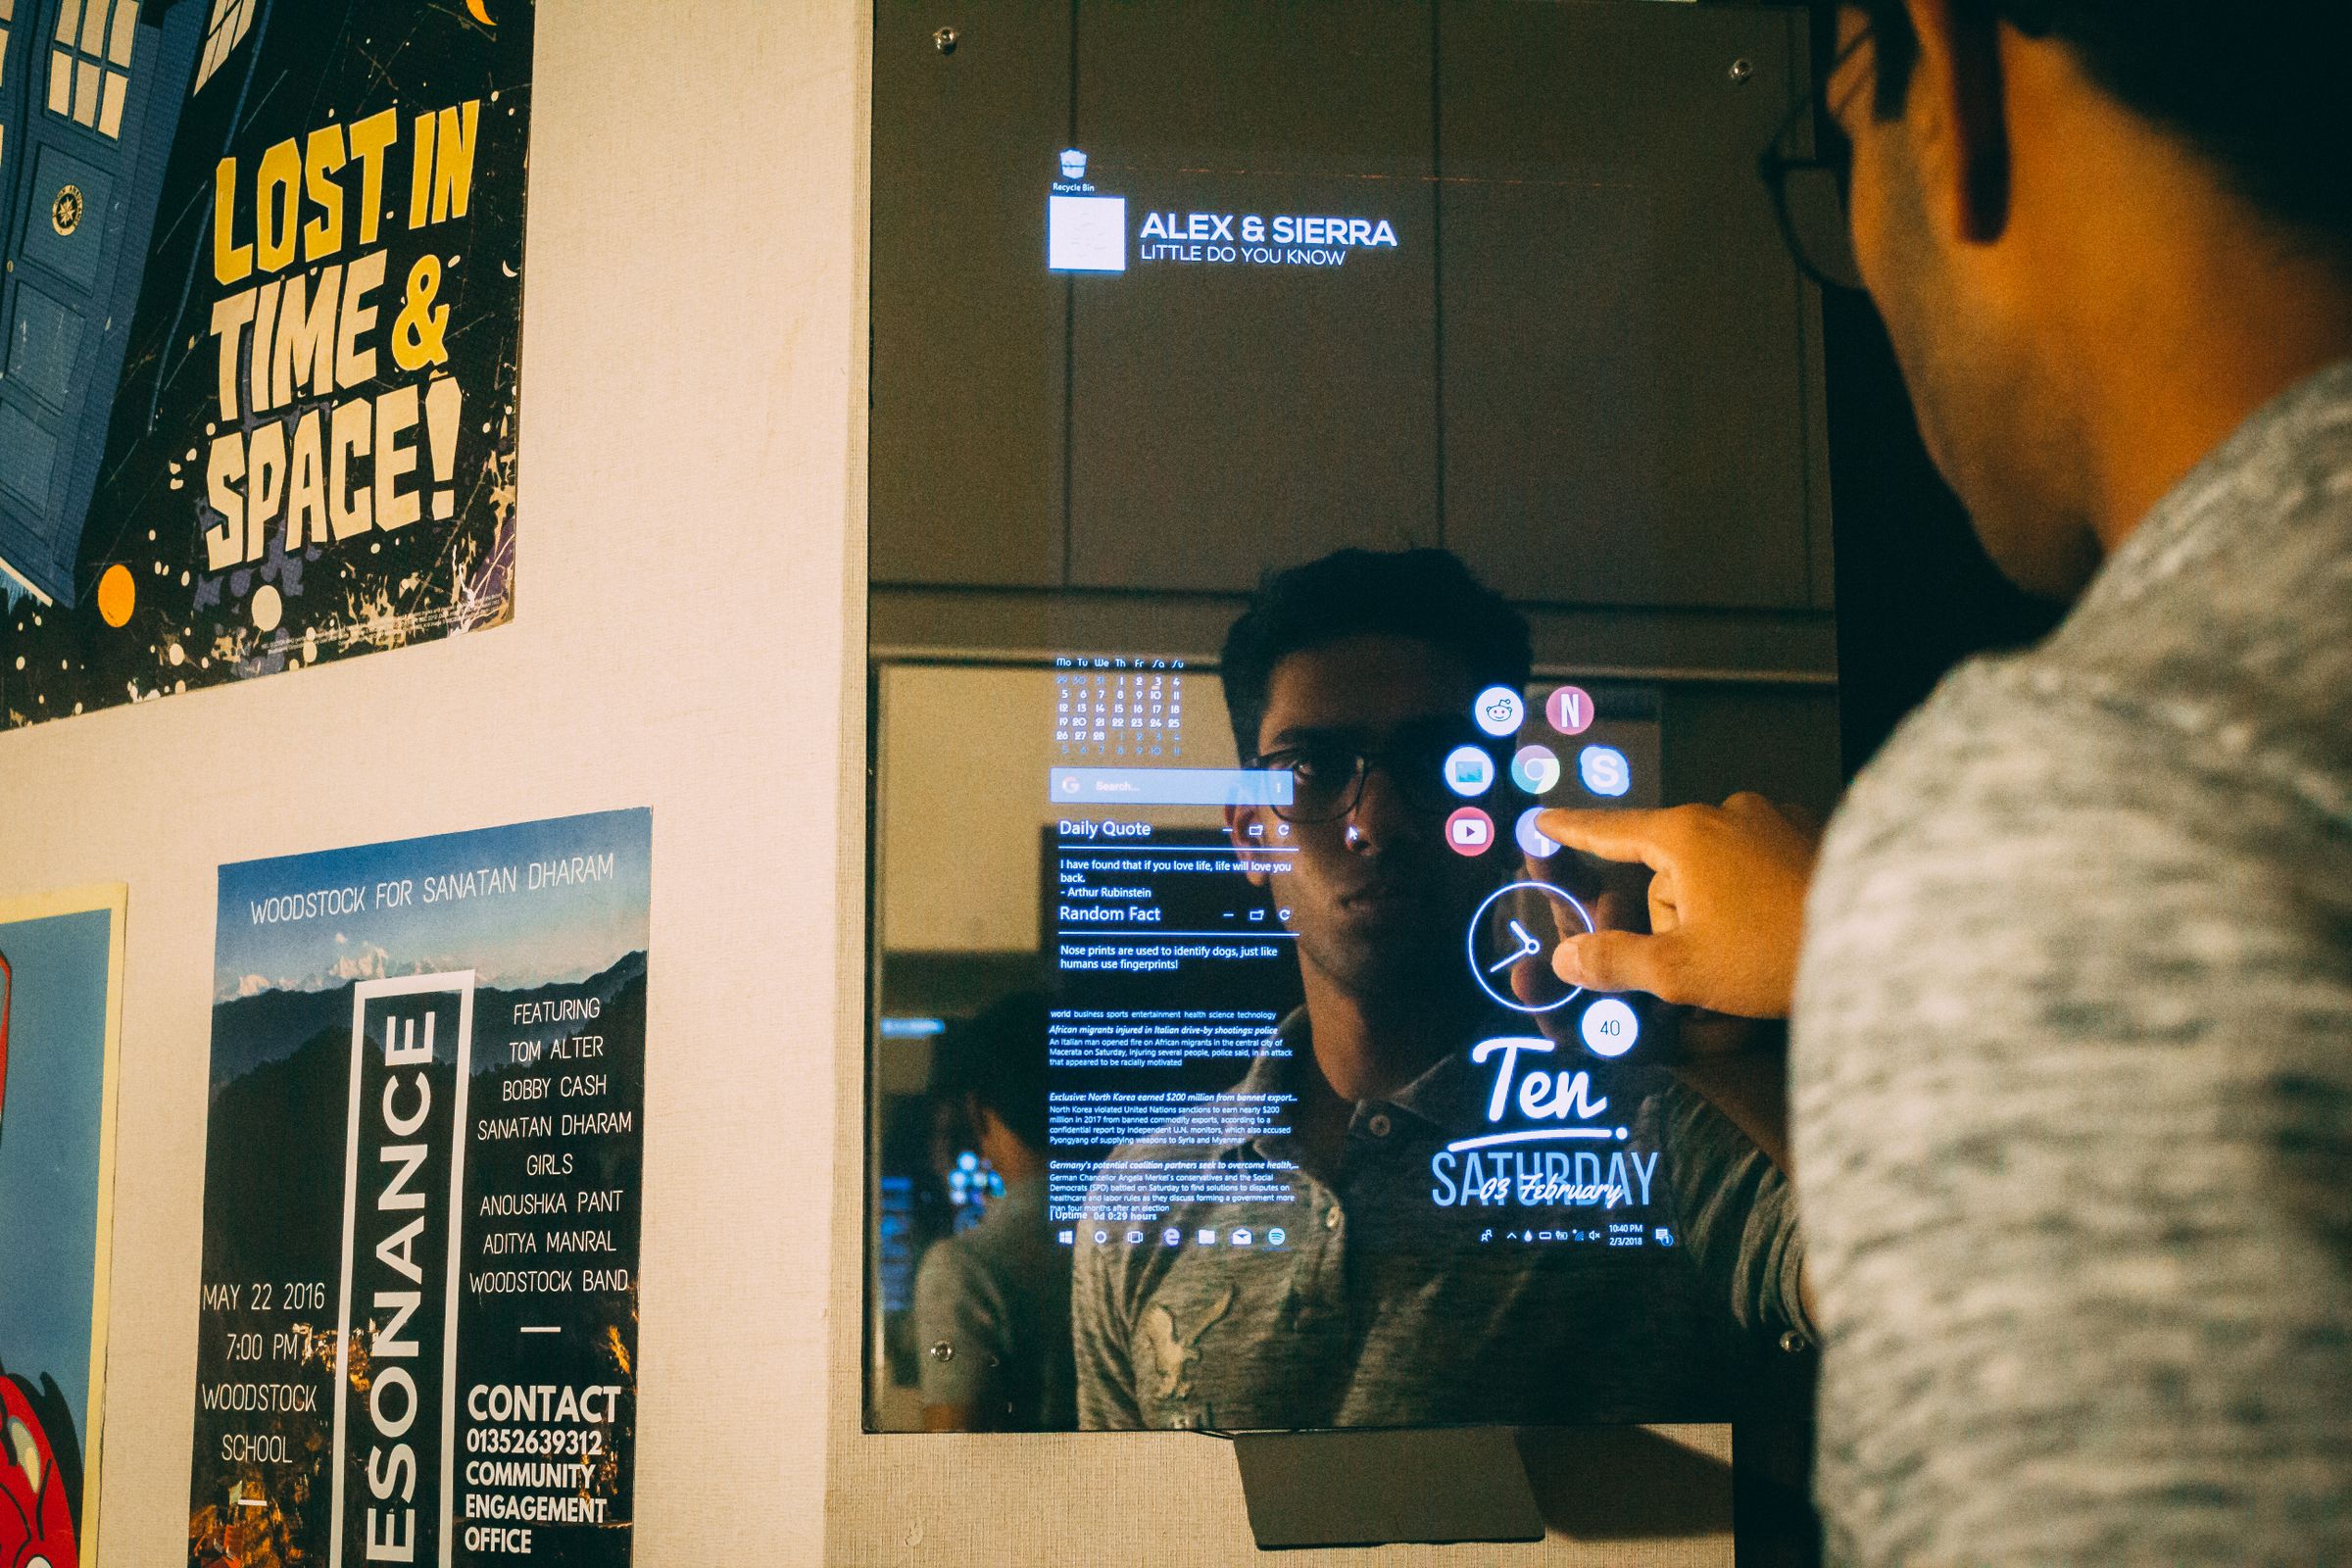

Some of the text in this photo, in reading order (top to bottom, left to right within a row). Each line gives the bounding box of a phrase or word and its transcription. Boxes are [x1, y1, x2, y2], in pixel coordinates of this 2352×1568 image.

[215, 99, 480, 286] LOST IN
[1053, 182, 1095, 192] Recycle Bin
[1140, 213, 1397, 246] ALEX & SIERRA
[1142, 245, 1346, 266] LITTLE DO YOU KNOW
[209, 249, 449, 422] TIME &
[206, 376, 464, 570] SPACE!
[1056, 659, 1071, 667] Mo
[1077, 659, 1088, 667] Tu
[1095, 659, 1109, 667] We
[1115, 659, 1125, 667] Th
[1152, 660, 1164, 668] Sa
[1171, 660, 1184, 668] Su
[1119, 677, 1180, 686] 1 2 3 4
[1061, 690, 1068, 699] 5
[1099, 691, 1104, 700] 7
[1117, 691, 1123, 700] 8
[1137, 691, 1142, 700] 9
[1173, 692, 1179, 701] 11
[1059, 704, 1068, 712] 12
[1096, 705, 1104, 713] 14
[1114, 705, 1123, 713] 15
[1134, 705, 1143, 713] 16
[1171, 706, 1180, 714] 18
[1560, 694, 1580, 727] N
[1059, 717, 1068, 726] 19
[1096, 718, 1104, 727] 21
[1112, 718, 1124, 727] 22
[1151, 719, 1161, 728] 24
[1168, 719, 1180, 728] 25
[1056, 732, 1104, 741] 26 27 28
[1592, 755, 1619, 788] S
[1096, 781, 1140, 792] Search...
[1059, 821, 1152, 839] Daily Quote
[1060, 873, 1085, 883] back.
[1067, 860, 1089, 869] have
[1092, 860, 1119, 869] found
[1123, 861, 1142, 870] that
[1145, 860, 1151, 870] if
[1152, 863, 1170, 872] you
[1174, 861, 1194, 870] love
[1197, 861, 1212, 872] life,
[1215, 861, 1230, 870] life
[1233, 861, 1249, 871] will
[1251, 862, 1271, 871] love
[1273, 864, 1292, 873] you
[251, 853, 614, 926] WOODSTOCK FOR SANATAN DHARAM
[1068, 887, 1152, 898] Arthur Rubinstein
[1060, 906, 1160, 921] Random Fact
[1061, 946, 1085, 956] Nose
[1089, 946, 1115, 957] prints
[1136, 947, 1158, 956] used
[1161, 948, 1172, 956] to
[1174, 947, 1210, 957] identify
[1212, 947, 1238, 957] dogs,
[1240, 947, 1258, 957] just
[1261, 948, 1277, 956] like
[1061, 959, 1099, 968] humans
[1120, 959, 1178, 971] fingerprints!
[514, 998, 601, 1025] FEATURING
[1106, 1011, 1128, 1020] sports
[1238, 1011, 1276, 1020] technology
[1079, 1026, 1114, 1036] migrants
[1116, 1026, 1143, 1036] injured
[1182, 1026, 1213, 1036] drive-by
[1215, 1026, 1253, 1036] shootings:
[1254, 1026, 1278, 1036] police
[1600, 1020, 1621, 1036] 40
[509, 1036, 604, 1063] TOM ALTER
[503, 1075, 607, 1102] BOBBY CASH
[1472, 1037, 1607, 1121] Ten
[1166, 1093, 1186, 1102] $200
[1268, 1095, 1298, 1103] export...
[477, 1111, 632, 1141] SANATAN DHARAM
[526, 1153, 573, 1176] GIRLS
[1432, 1152, 1658, 1206] SATURDAY
[1479, 1173, 1624, 1208] 03 February
[480, 1191, 623, 1216] ANOUSHKA PANT
[1055, 1210, 1088, 1220] Uptime
[1609, 1224, 1642, 1233] 10:40 PM
[483, 1230, 616, 1254] ADITYA MANRAL
[1609, 1237, 1642, 1246] 2/3/2018
[469, 1269, 628, 1294] WOODSTOCK BAND
[202, 1282, 325, 1311] MAY 22 2016
[226, 1333, 298, 1360] 7:00 PM
[202, 1384, 317, 1411] WOODSTOCK
[467, 1385, 621, 1424] CONTACT
[220, 1435, 293, 1463] SCHOOL
[466, 1430, 603, 1455] 01352639312
[466, 1460, 596, 1490] COMMUNITY
[466, 1494, 607, 1524] ENGAGEMENT
[465, 1527, 531, 1554] OFFICE
